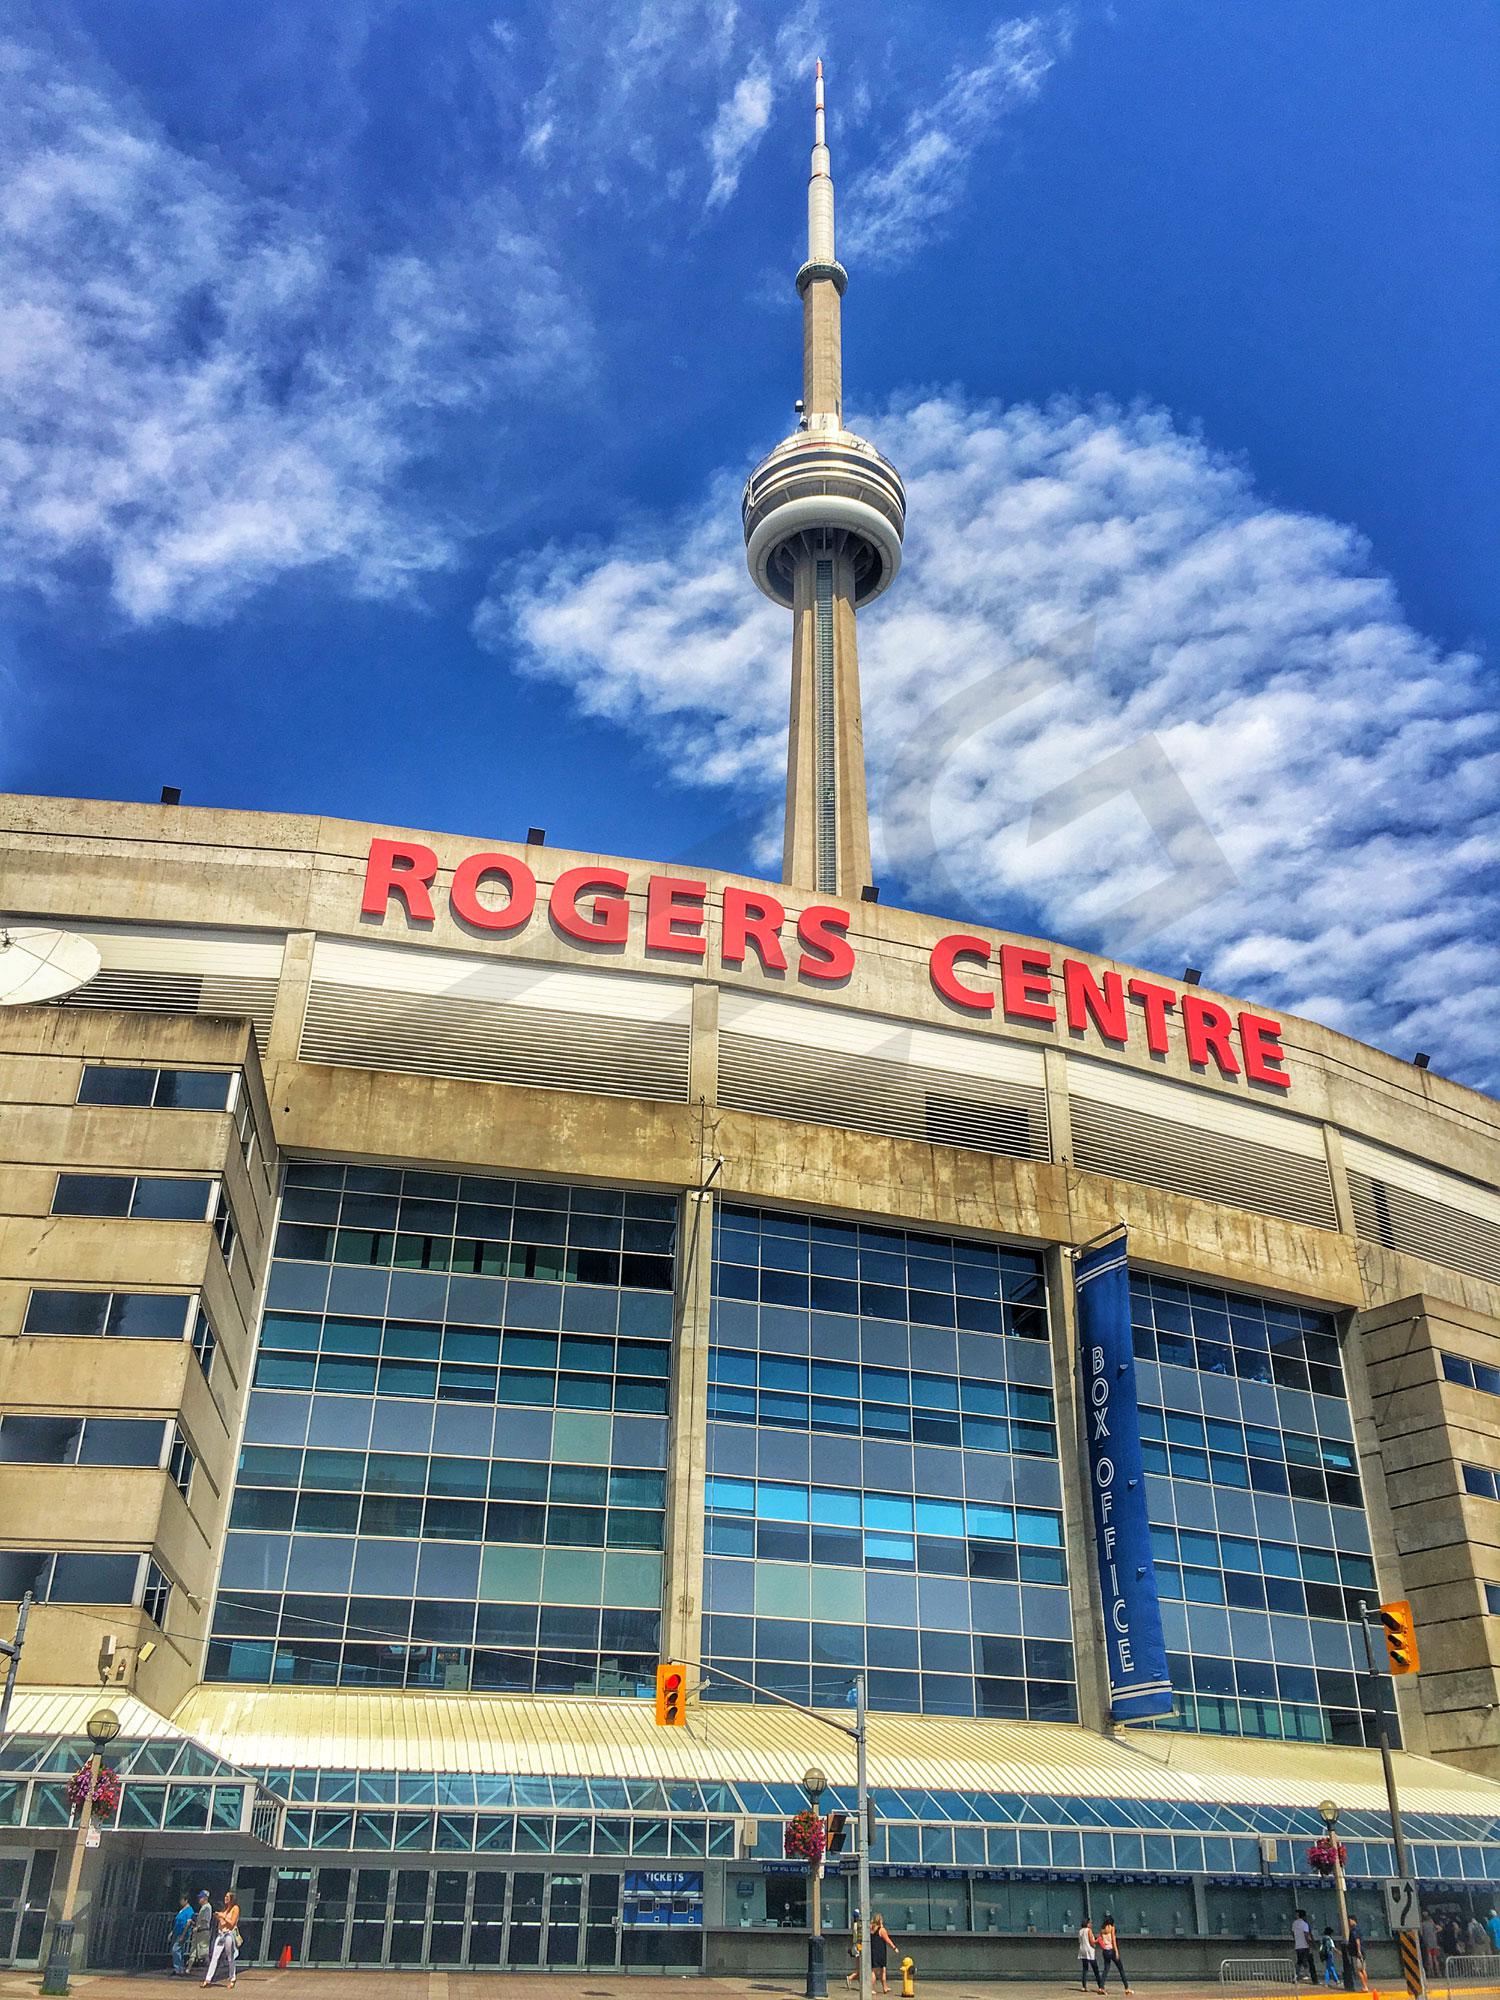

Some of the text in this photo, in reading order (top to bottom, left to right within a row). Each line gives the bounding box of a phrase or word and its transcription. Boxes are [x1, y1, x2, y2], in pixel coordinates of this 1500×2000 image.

[361, 837, 1292, 1089] ROGERS CENTRE
[1091, 1345, 1135, 1674] BOX OFFICE
[644, 1871, 685, 1882] TICKETS
